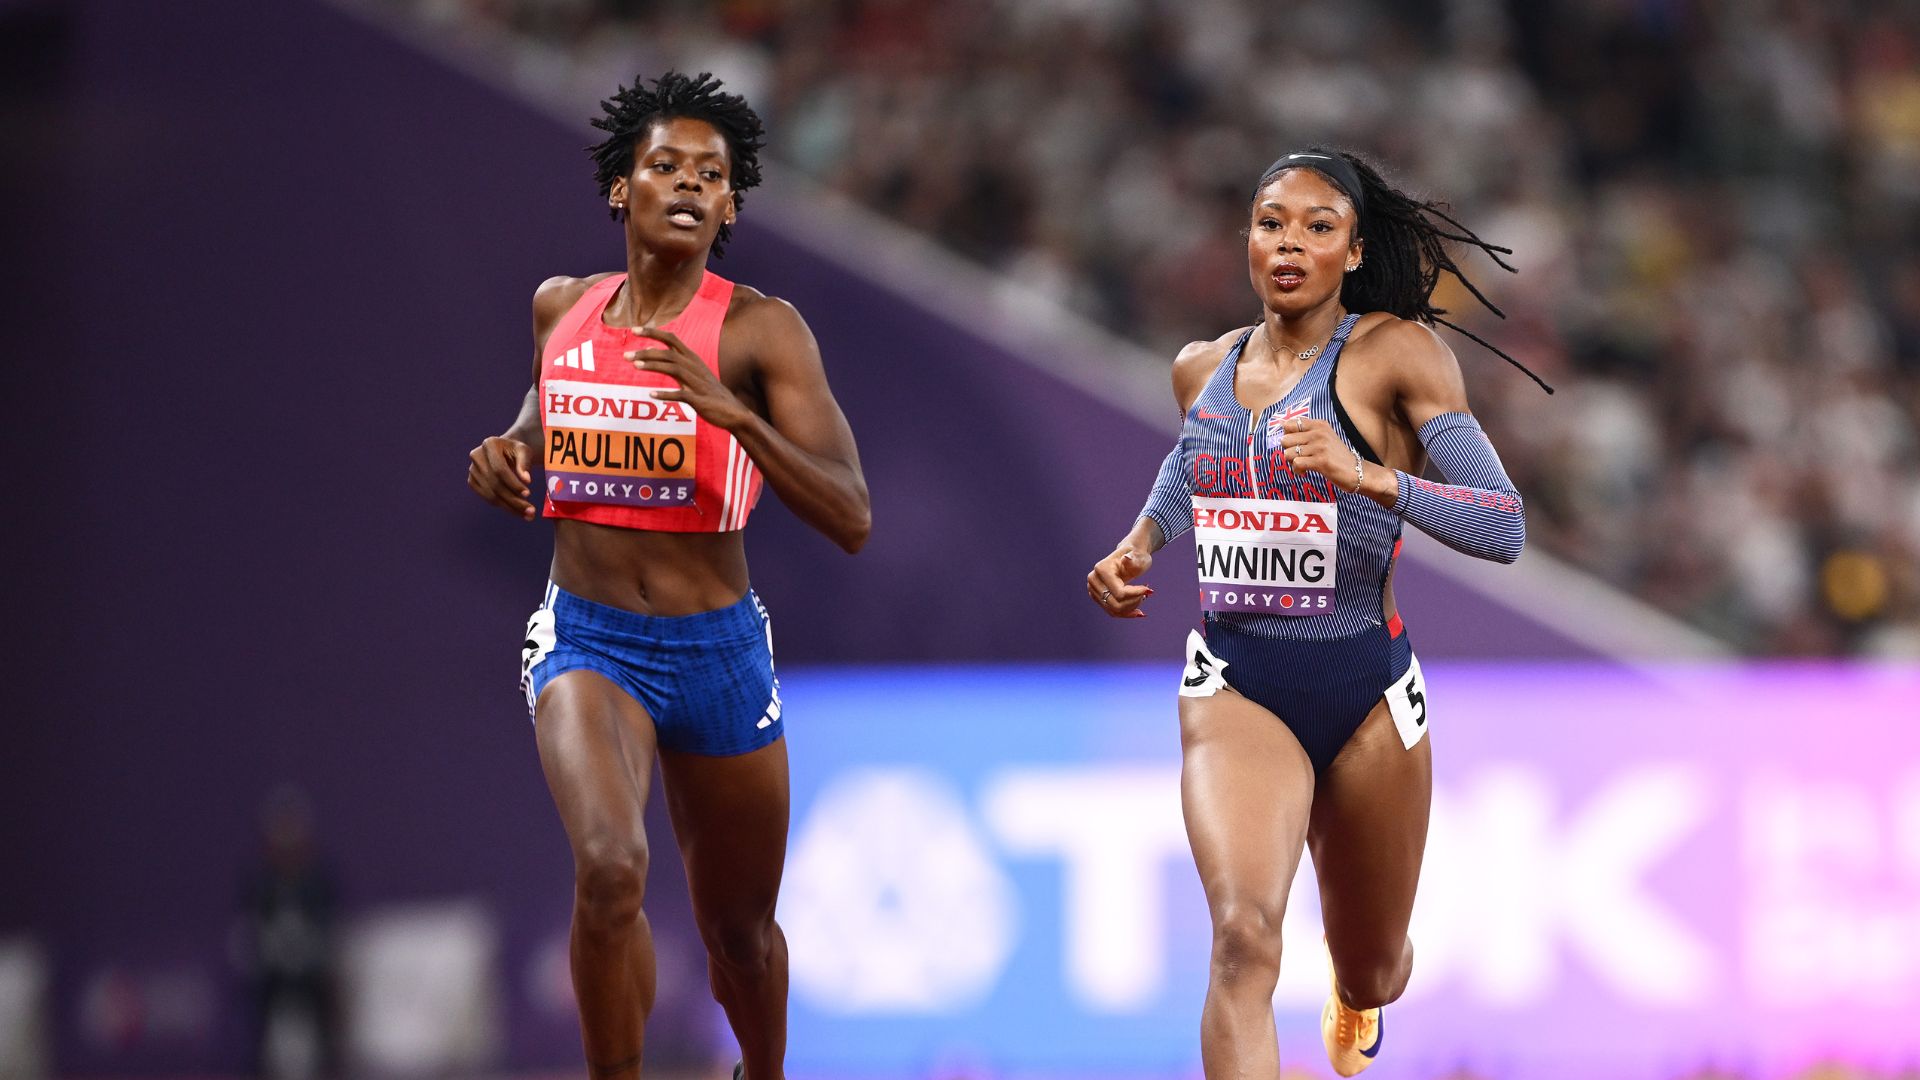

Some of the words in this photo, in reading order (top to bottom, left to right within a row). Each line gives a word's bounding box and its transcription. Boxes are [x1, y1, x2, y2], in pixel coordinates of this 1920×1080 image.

[549, 393, 692, 422] HONDA
[549, 430, 685, 472] PAULINO
[1193, 450, 1308, 489] GREA
[1193, 508, 1333, 534] HONDA
[1405, 675, 1426, 727] 5
